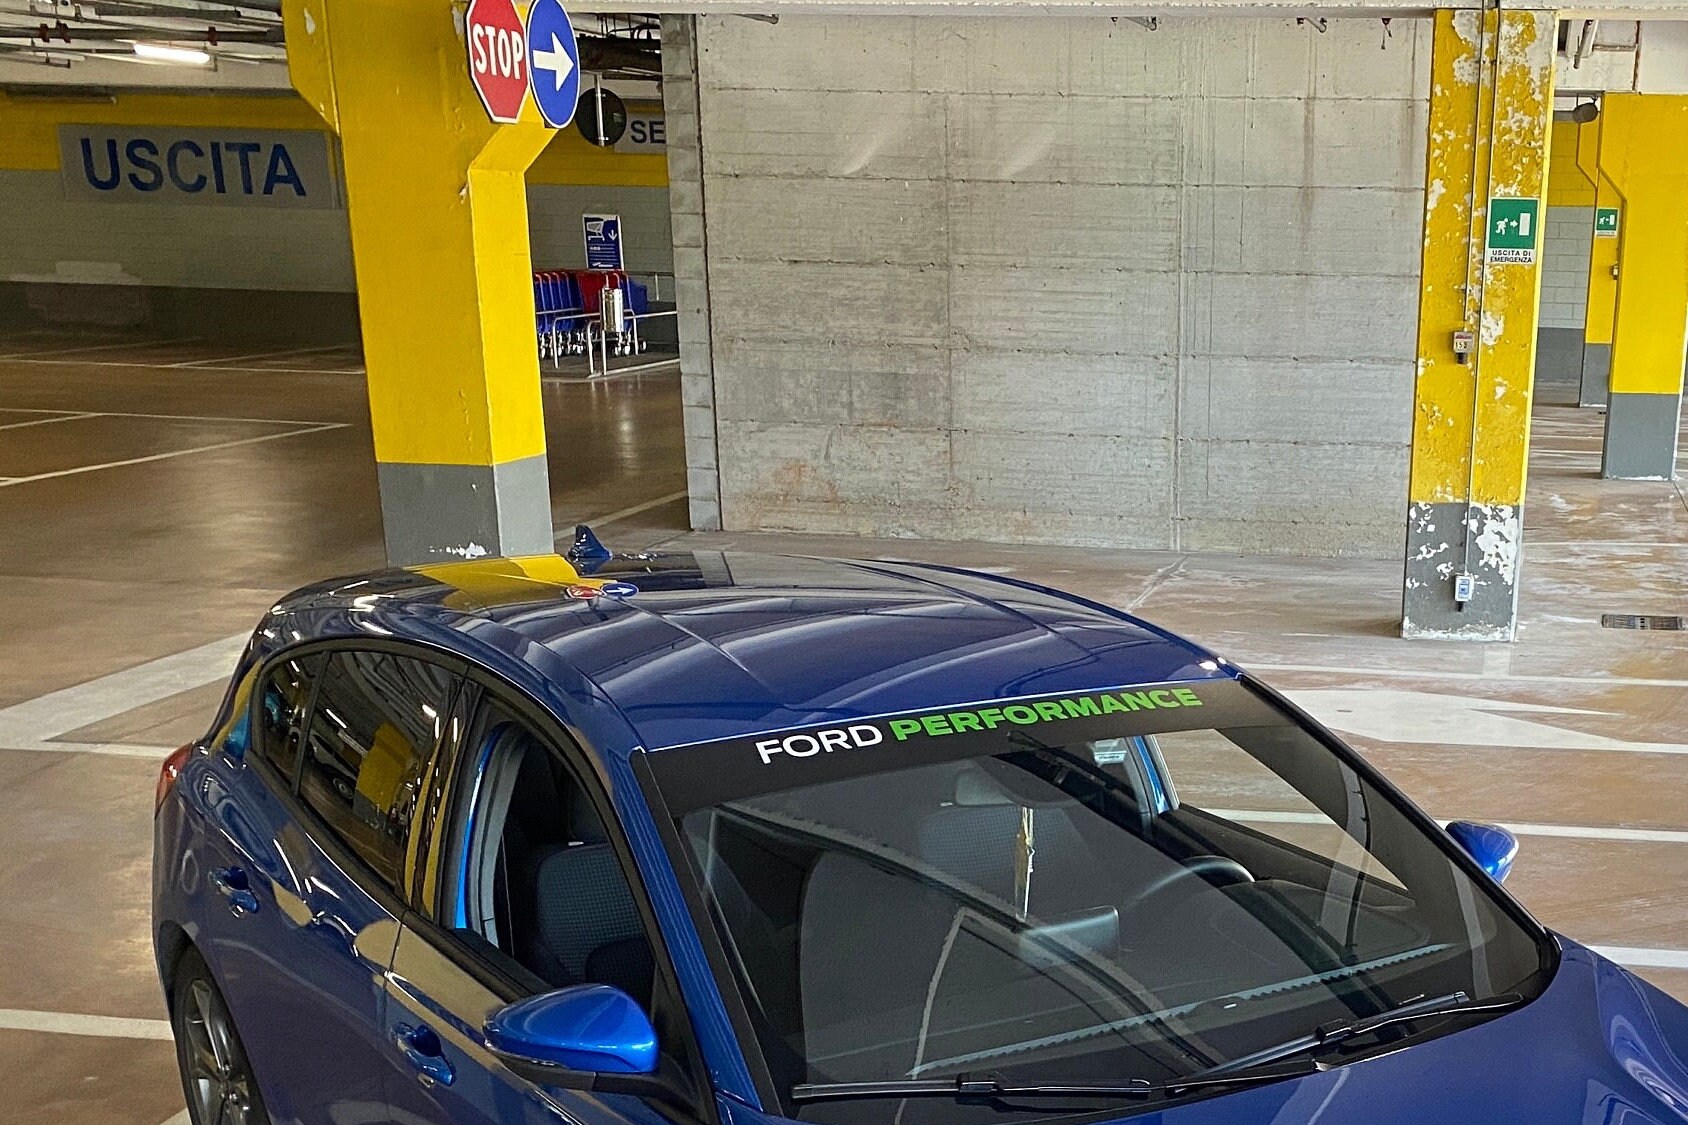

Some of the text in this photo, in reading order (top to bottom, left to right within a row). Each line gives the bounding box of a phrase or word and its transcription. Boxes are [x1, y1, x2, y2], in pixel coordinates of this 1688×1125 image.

[472, 23, 524, 80] STOP
[630, 120, 666, 144] SE
[80, 137, 306, 197] USCITA
[1492, 249, 1520, 257] USCITA
[756, 688, 1203, 765] FORD PERFORMANCE
